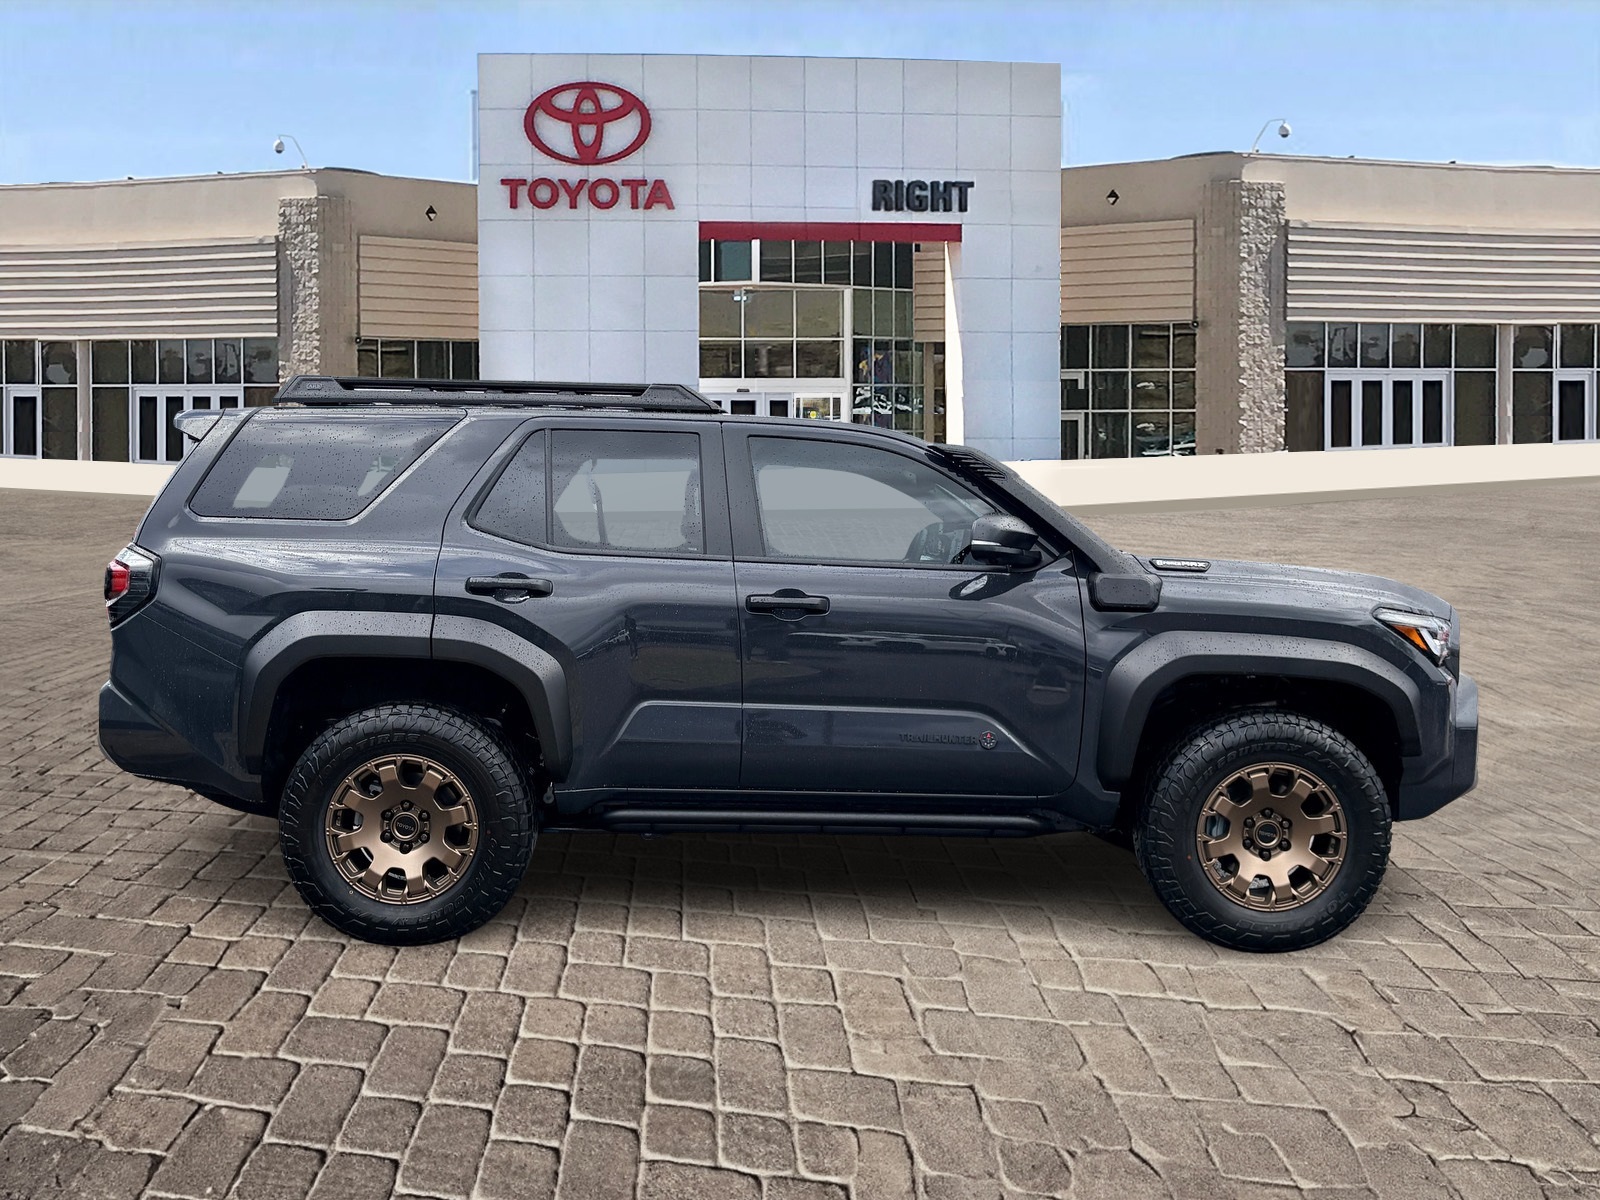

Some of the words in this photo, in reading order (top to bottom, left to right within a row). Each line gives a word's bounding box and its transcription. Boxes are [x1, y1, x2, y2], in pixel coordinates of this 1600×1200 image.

[500, 177, 675, 210] TOYOTA
[872, 179, 975, 212] RIGHT
[898, 732, 978, 746] TRAILHUNTER
[396, 821, 415, 831] TOYOTA
